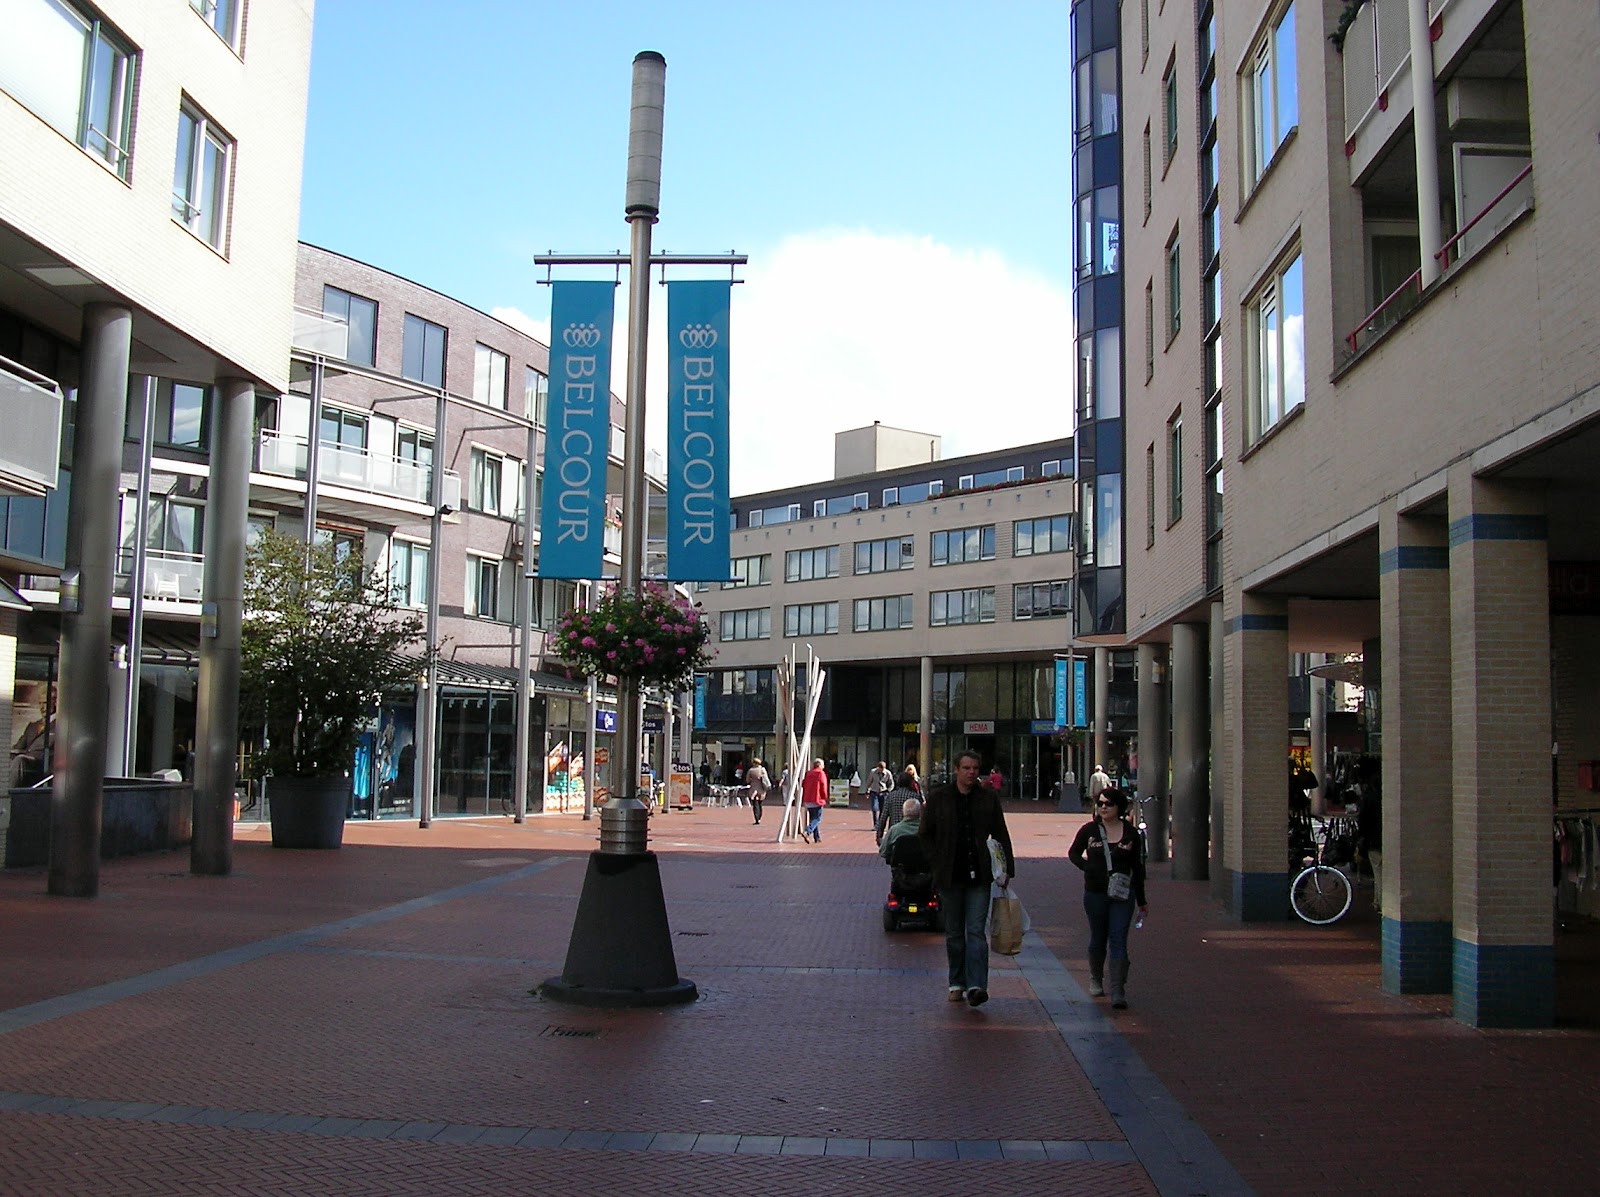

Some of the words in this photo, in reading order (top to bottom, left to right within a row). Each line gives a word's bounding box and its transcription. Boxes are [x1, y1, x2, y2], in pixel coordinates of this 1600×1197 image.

[557, 354, 596, 545] BELCOUR
[683, 355, 715, 547] BELCOUR
[969, 723, 988, 732] HEMA
